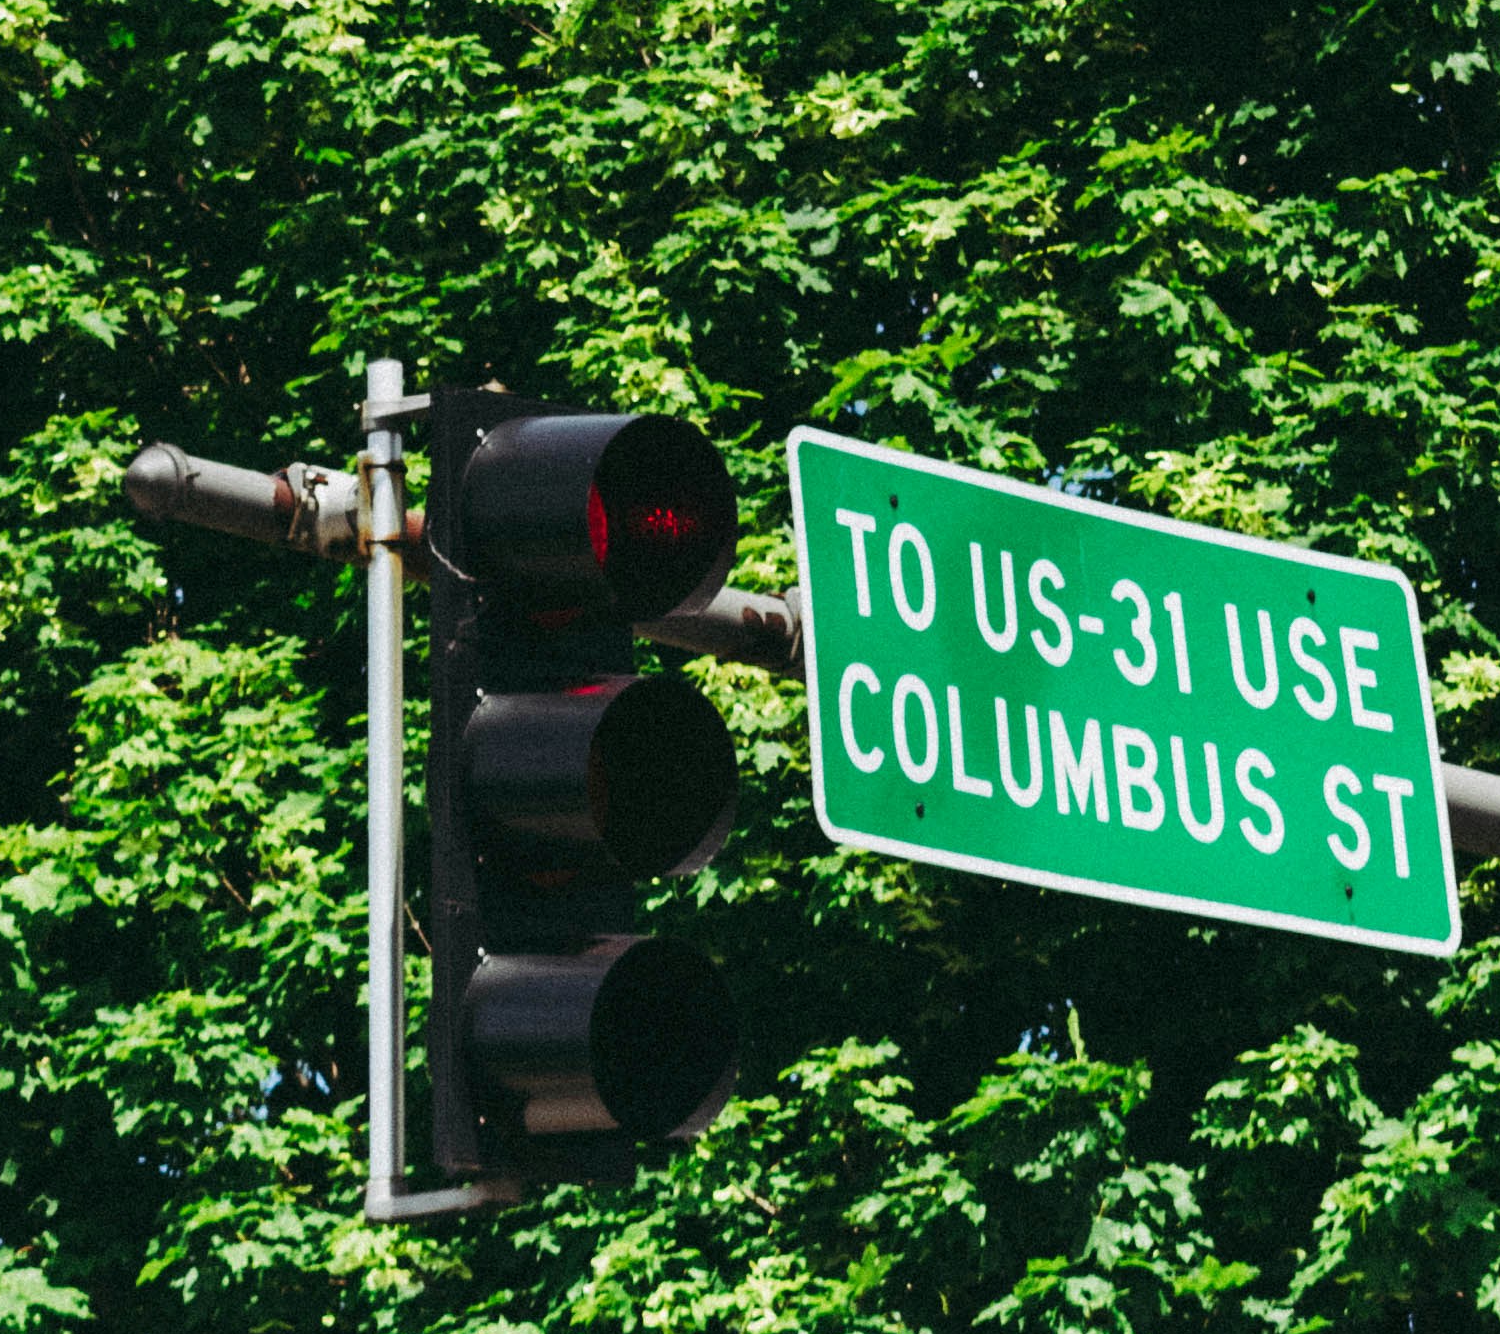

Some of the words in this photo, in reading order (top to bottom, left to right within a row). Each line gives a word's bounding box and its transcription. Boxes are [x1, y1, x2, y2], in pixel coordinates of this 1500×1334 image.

[836, 509, 935, 630] TO
[970, 543, 1191, 693] US-31
[1225, 604, 1393, 731] USE
[839, 663, 1284, 853] COLUMBUS
[1324, 766, 1413, 877] ST
